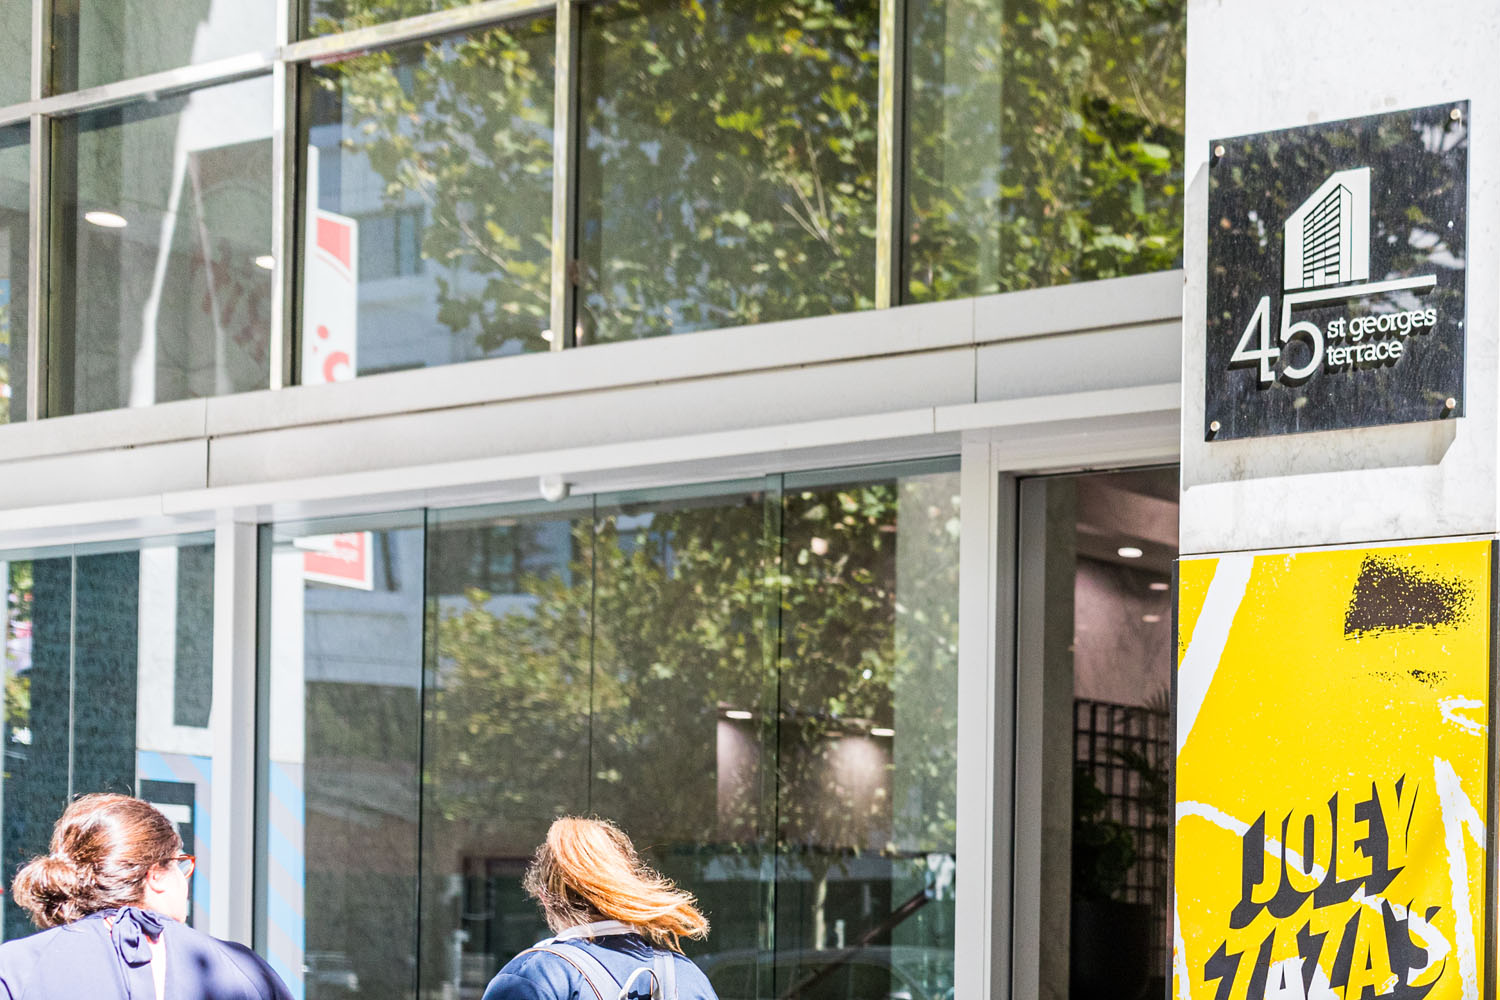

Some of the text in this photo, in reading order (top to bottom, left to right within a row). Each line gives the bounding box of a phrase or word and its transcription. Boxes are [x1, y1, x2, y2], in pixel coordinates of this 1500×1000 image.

[1230, 291, 1324, 382] 45
[1327, 308, 1437, 341] st georges
[1327, 340, 1403, 366] terrace
[1229, 772, 1420, 930] JOEY
